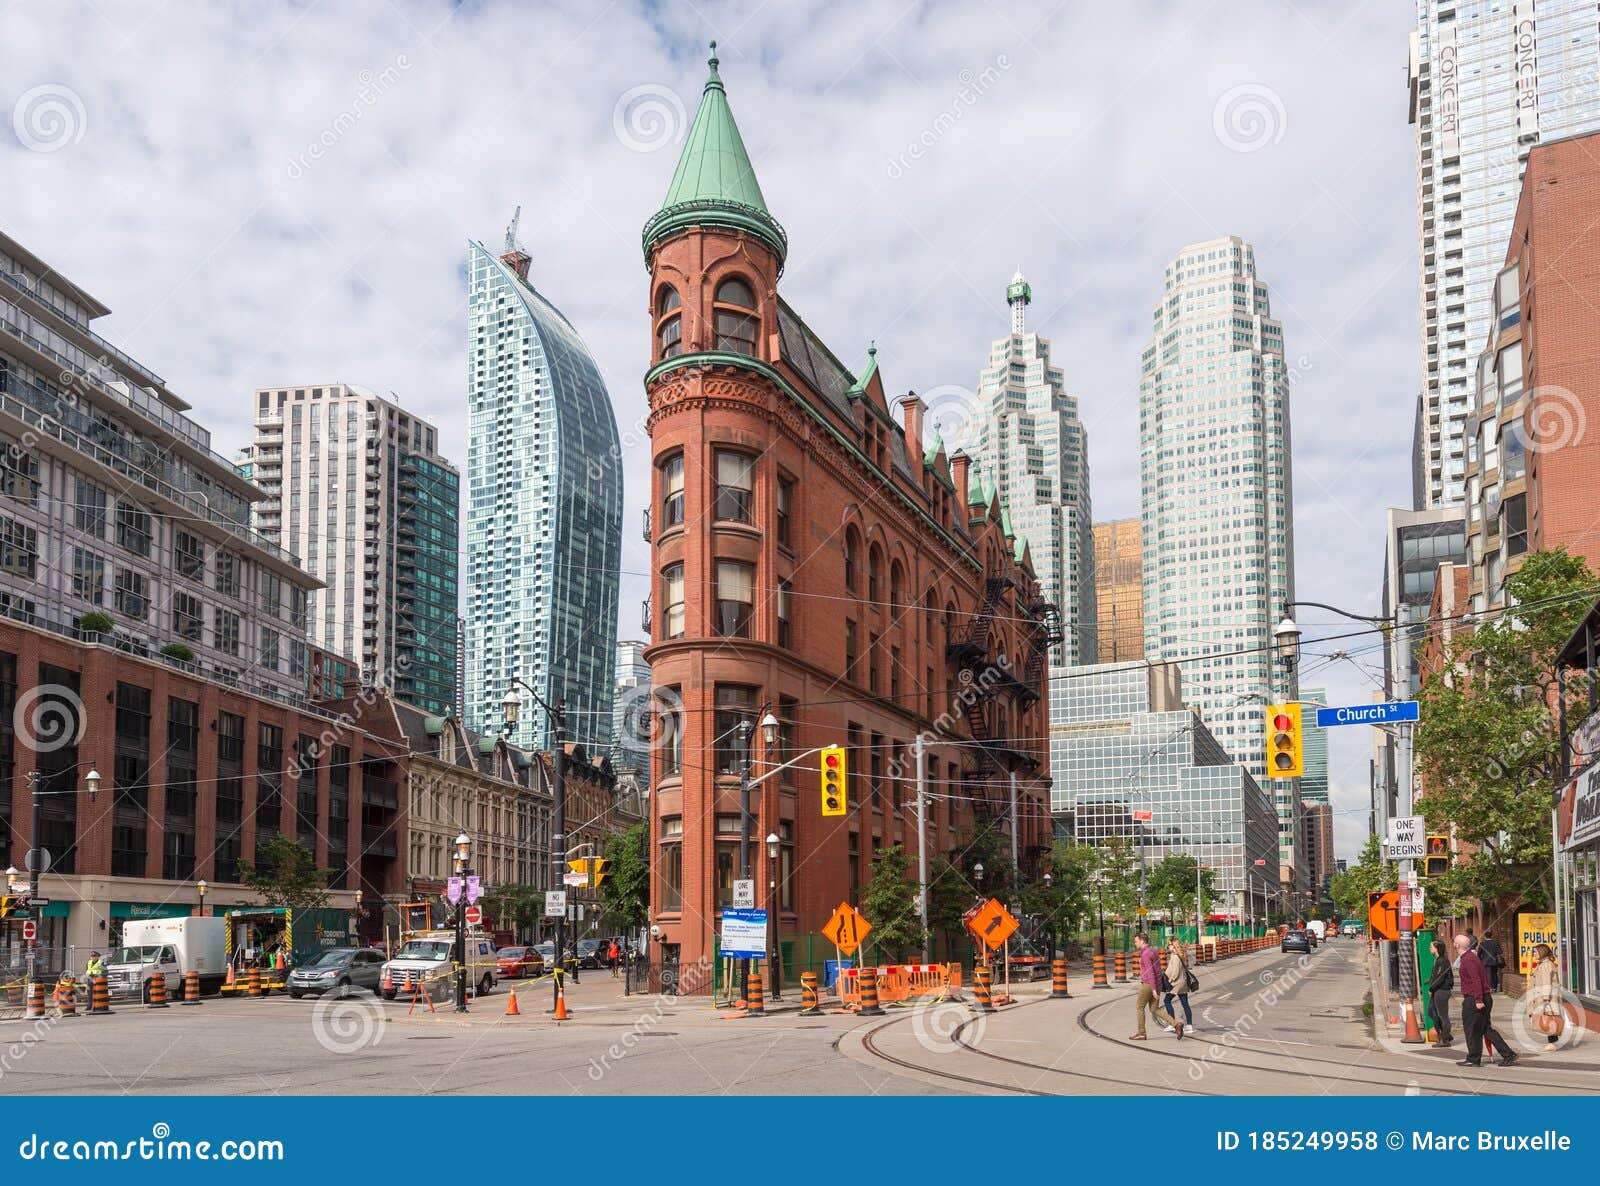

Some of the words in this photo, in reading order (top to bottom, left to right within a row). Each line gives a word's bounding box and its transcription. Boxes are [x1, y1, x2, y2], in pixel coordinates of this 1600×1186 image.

[1519, 20, 1535, 111] CONCERT
[1440, 46, 1456, 135] CONCERT
[1336, 706, 1386, 721] Church
[1396, 820, 1415, 830] ONE
[1396, 832, 1415, 842] WAY
[1390, 845, 1424, 855] BEGINS
[1523, 931, 1557, 943] PUBLIC
